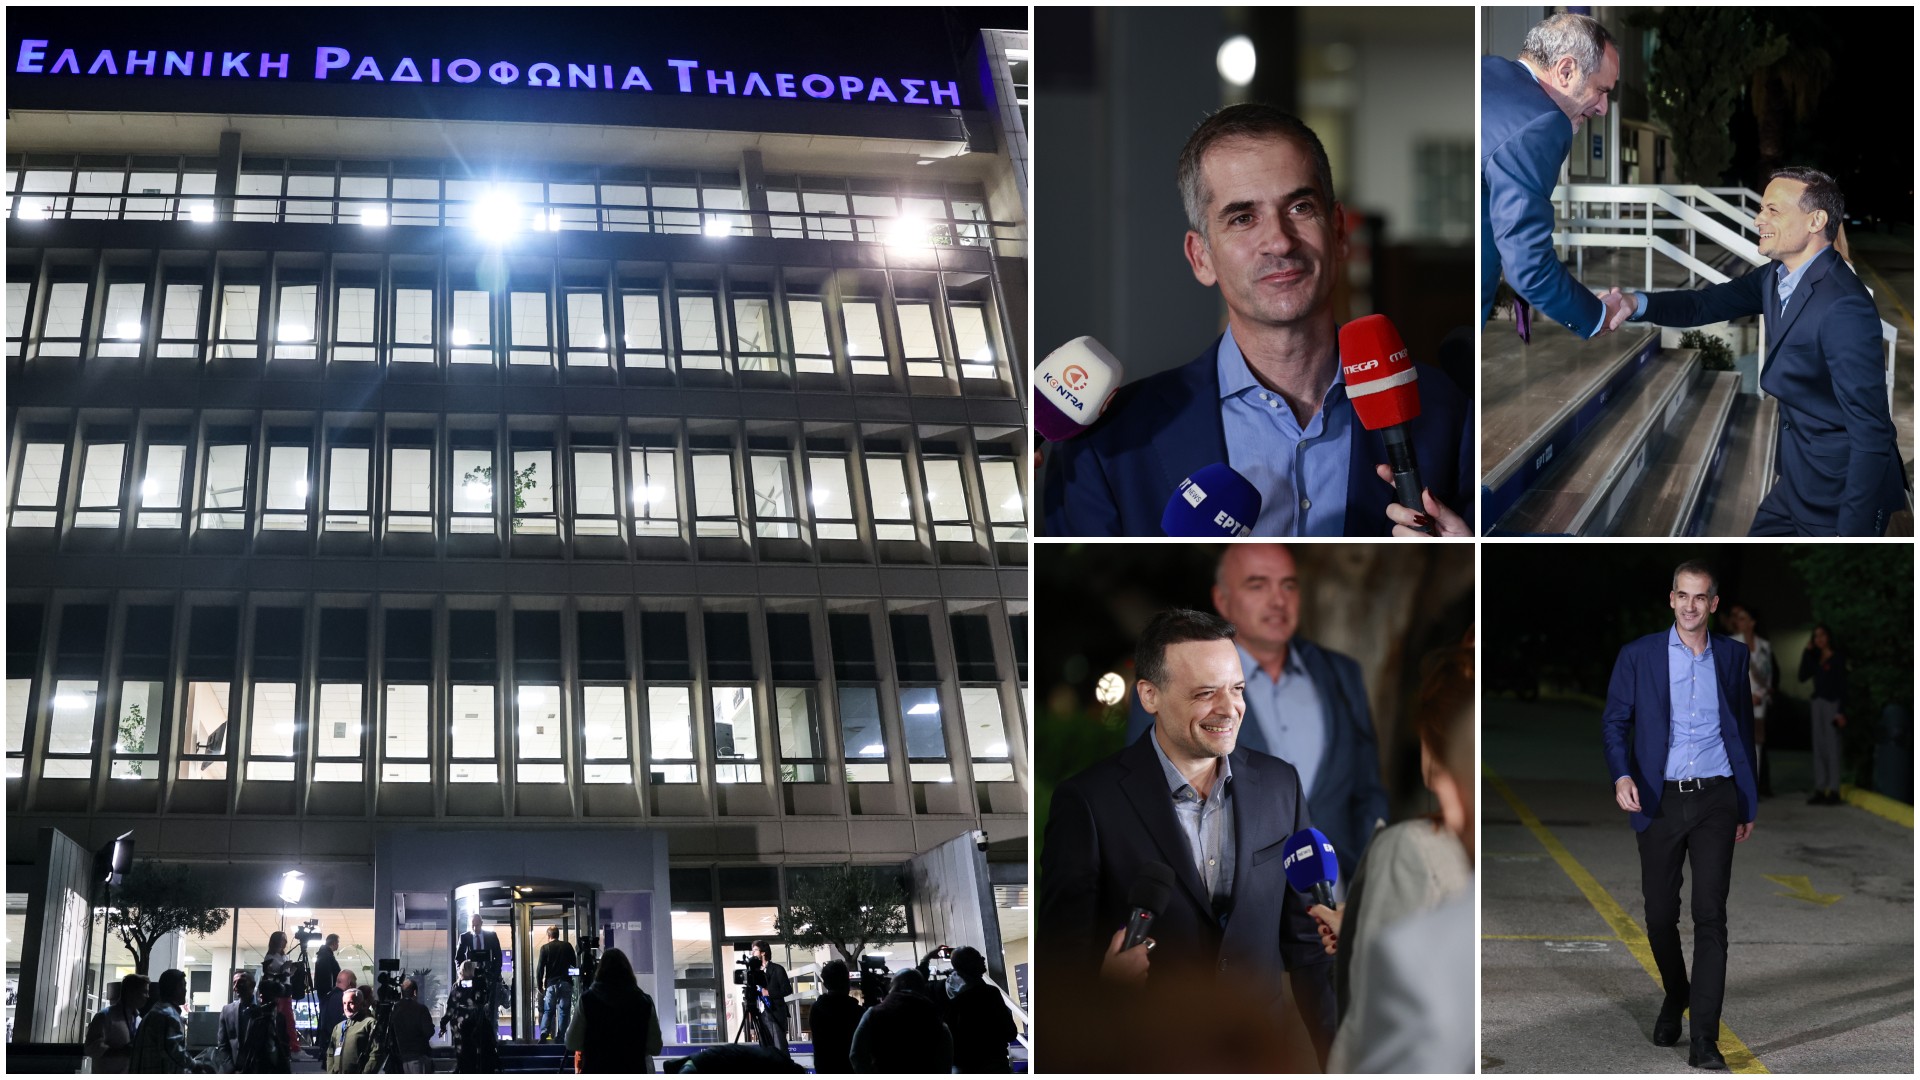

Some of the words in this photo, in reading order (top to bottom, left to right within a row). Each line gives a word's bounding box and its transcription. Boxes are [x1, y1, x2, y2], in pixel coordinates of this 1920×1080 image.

[16, 39, 290, 78] ΕΛΛΗΝΙΚΗ
[315, 47, 653, 91] ΡΑΔΙΟΦΩΝΙΑ
[668, 59, 960, 106] ΤΗΛΕΟΡΑΣΗ
[1343, 359, 1379, 375] MEGA
[1043, 372, 1084, 411] KONTRA
[1187, 488, 1202, 503] NEWS
